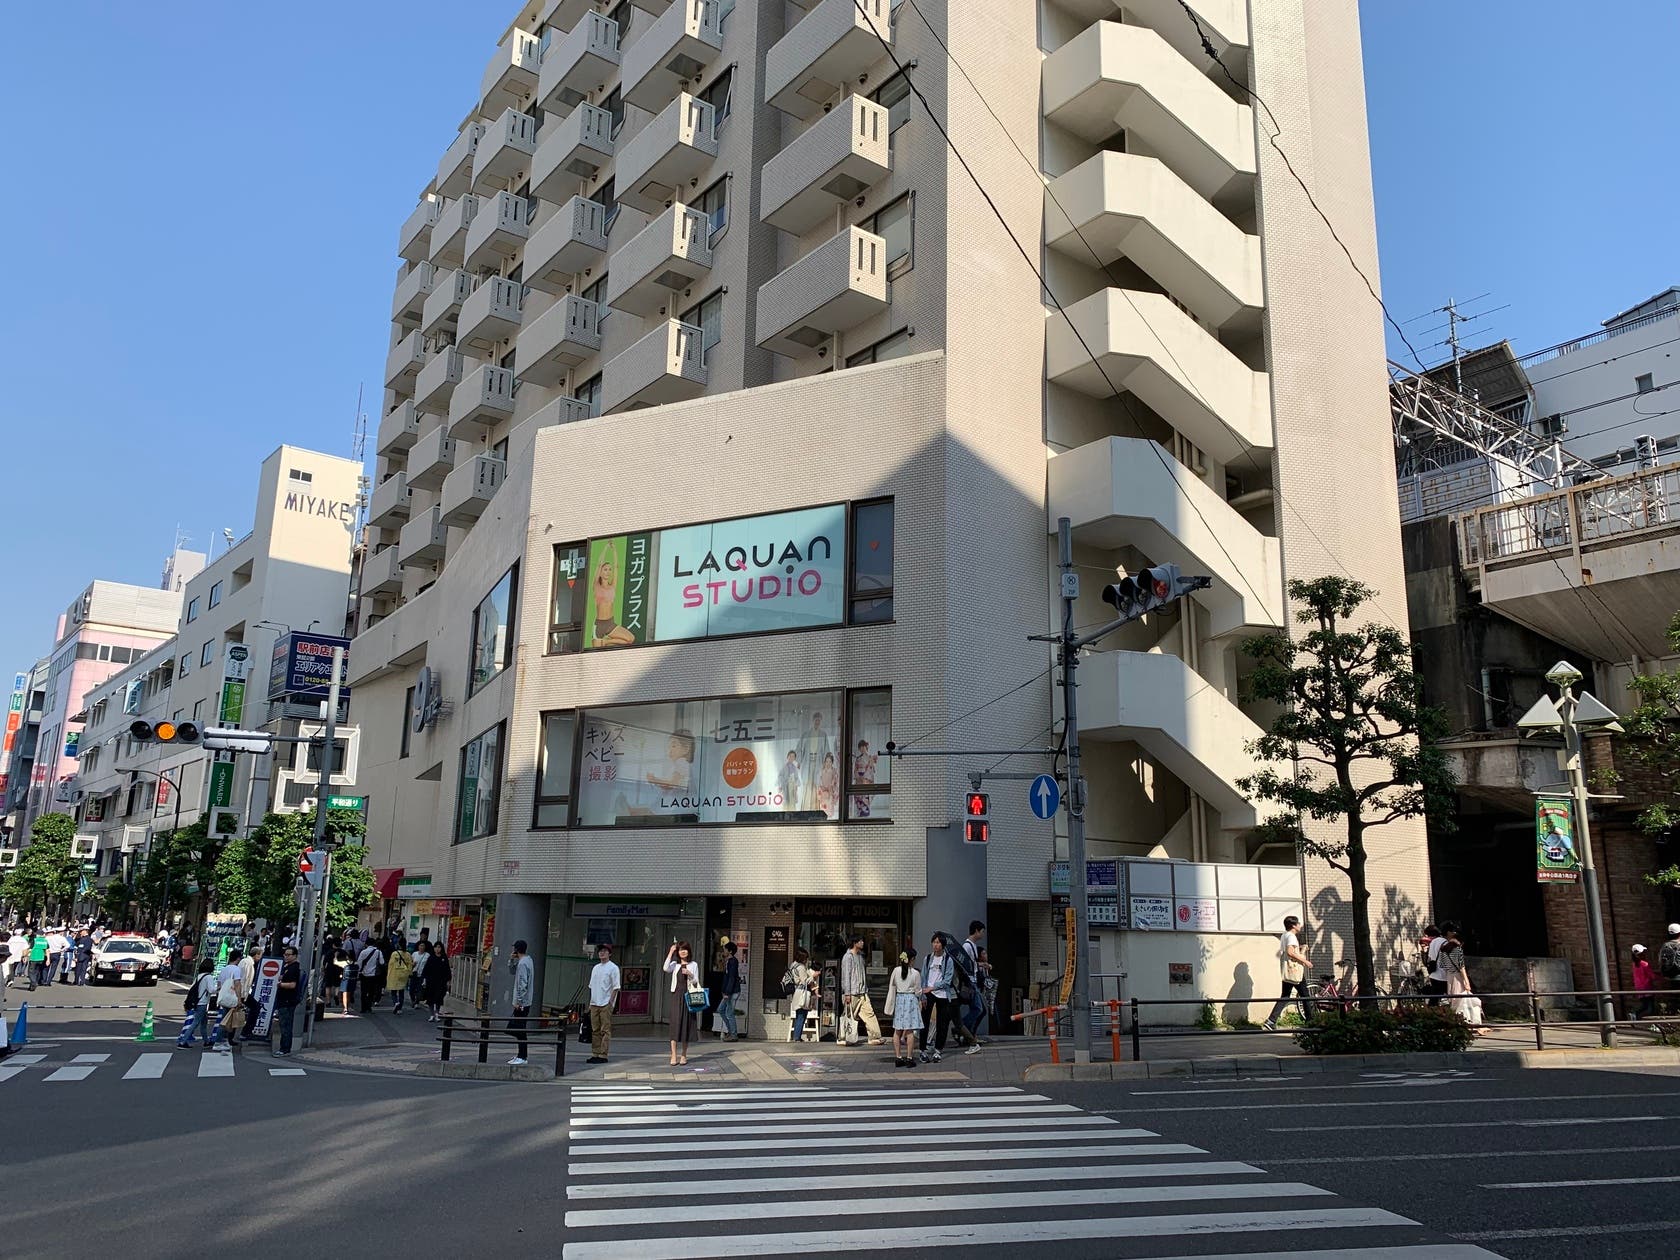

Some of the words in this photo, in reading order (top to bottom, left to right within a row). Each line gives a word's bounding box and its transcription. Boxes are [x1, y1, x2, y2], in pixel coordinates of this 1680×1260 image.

[284, 491, 349, 522] MIYAKE
[627, 539, 645, 630] ヨガプラス
[584, 726, 625, 746] キッズ
[710, 717, 776, 744] 七五三
[584, 747, 625, 764] ベビー
[588, 765, 618, 783] 撮影
[331, 798, 359, 807] 平和通り
[607, 905, 649, 914] FamilyMart
[257, 978, 274, 1028] 車両進入禁止
